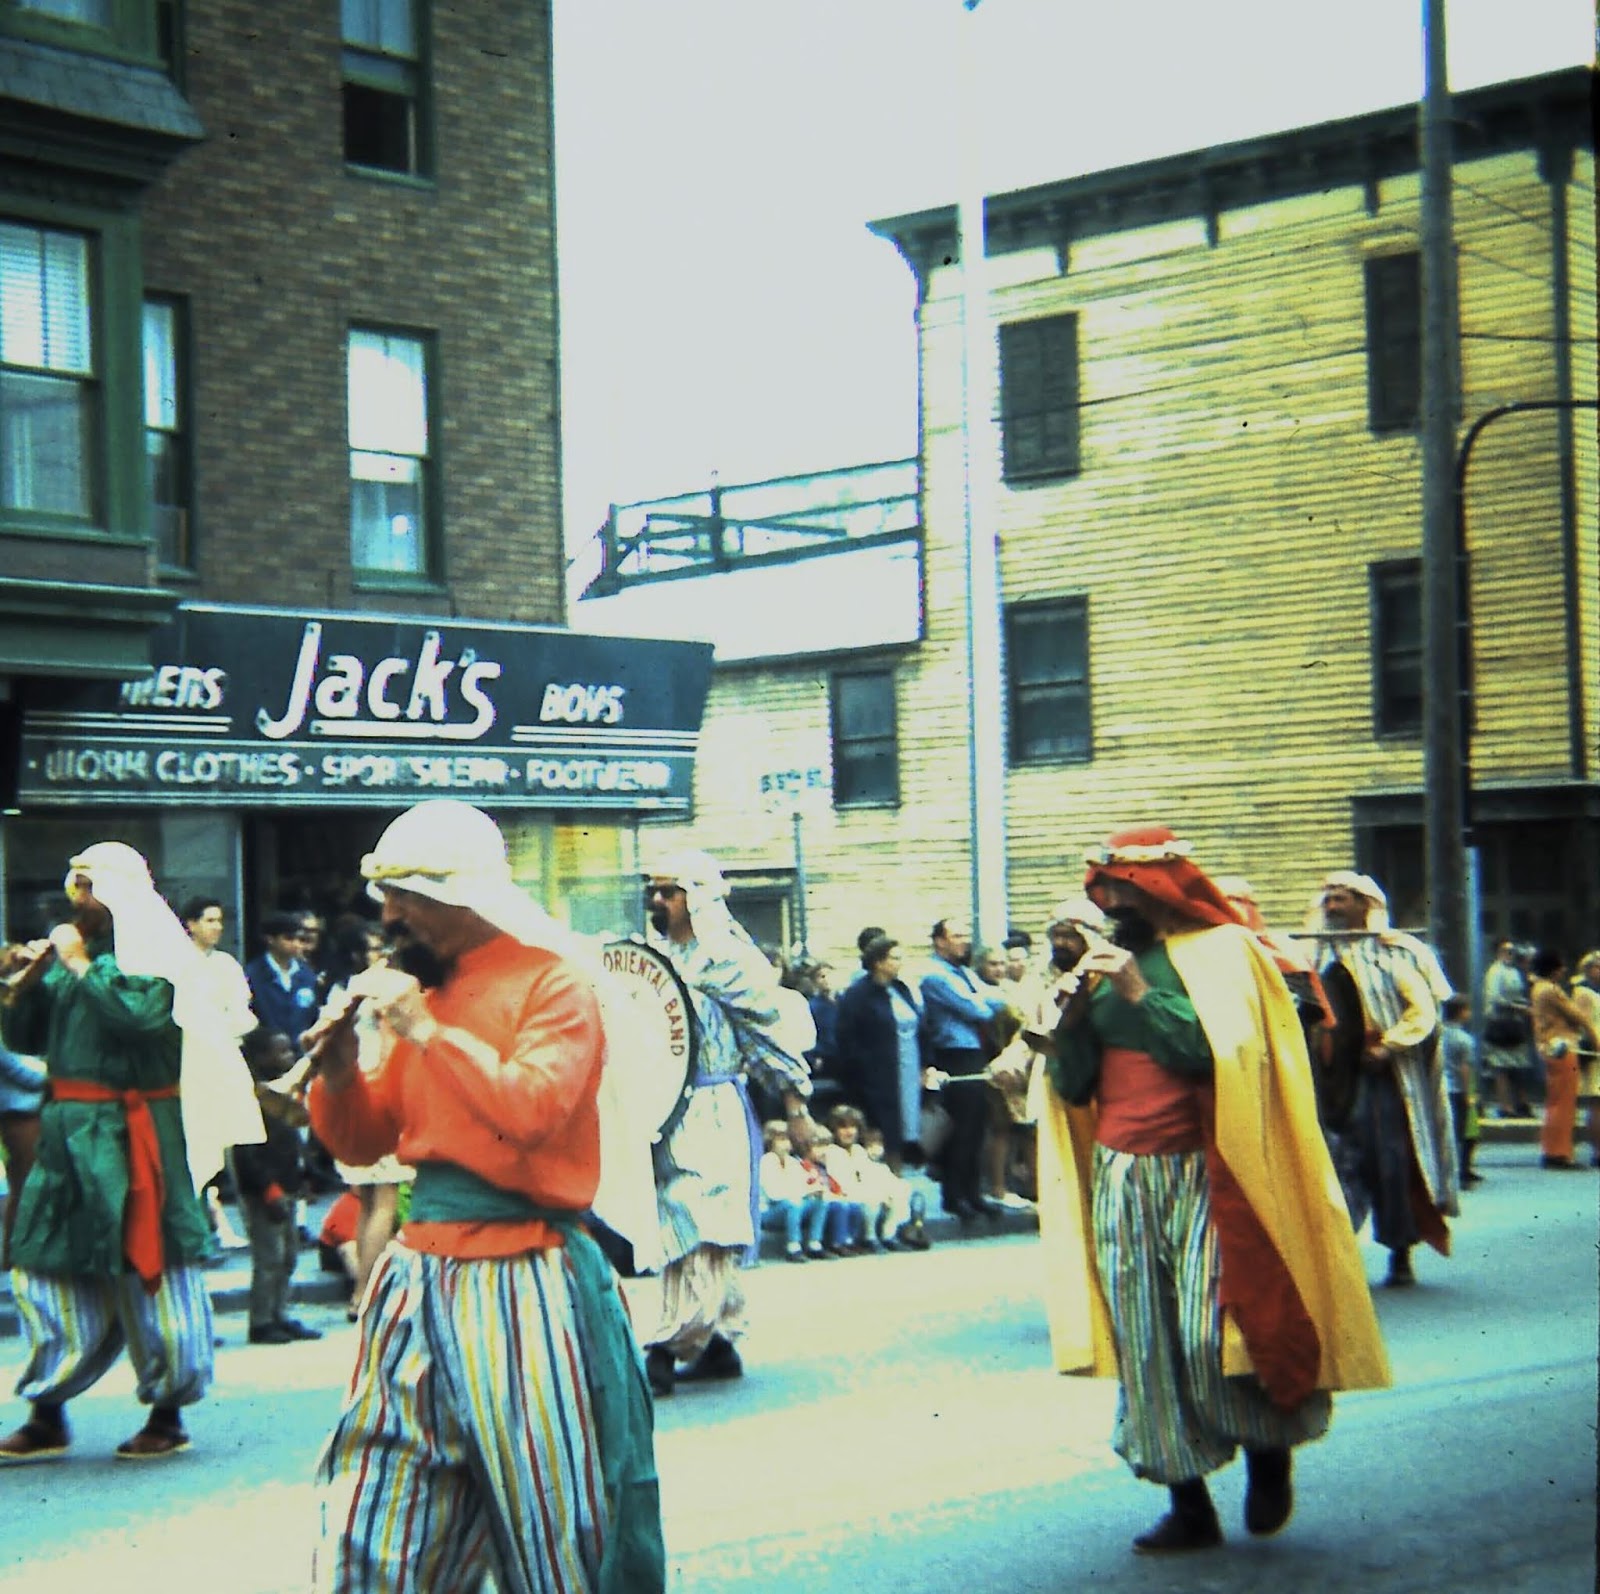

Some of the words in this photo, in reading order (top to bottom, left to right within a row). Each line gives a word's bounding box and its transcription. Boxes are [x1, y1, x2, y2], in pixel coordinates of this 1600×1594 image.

[256, 621, 502, 739] Jack's
[540, 683, 626, 724] BOYS
[45, 749, 148, 782] WORK
[156, 750, 299, 786] CLOTHES
[603, 949, 671, 998] ORIENTAL
[664, 998, 685, 1057] BAND
